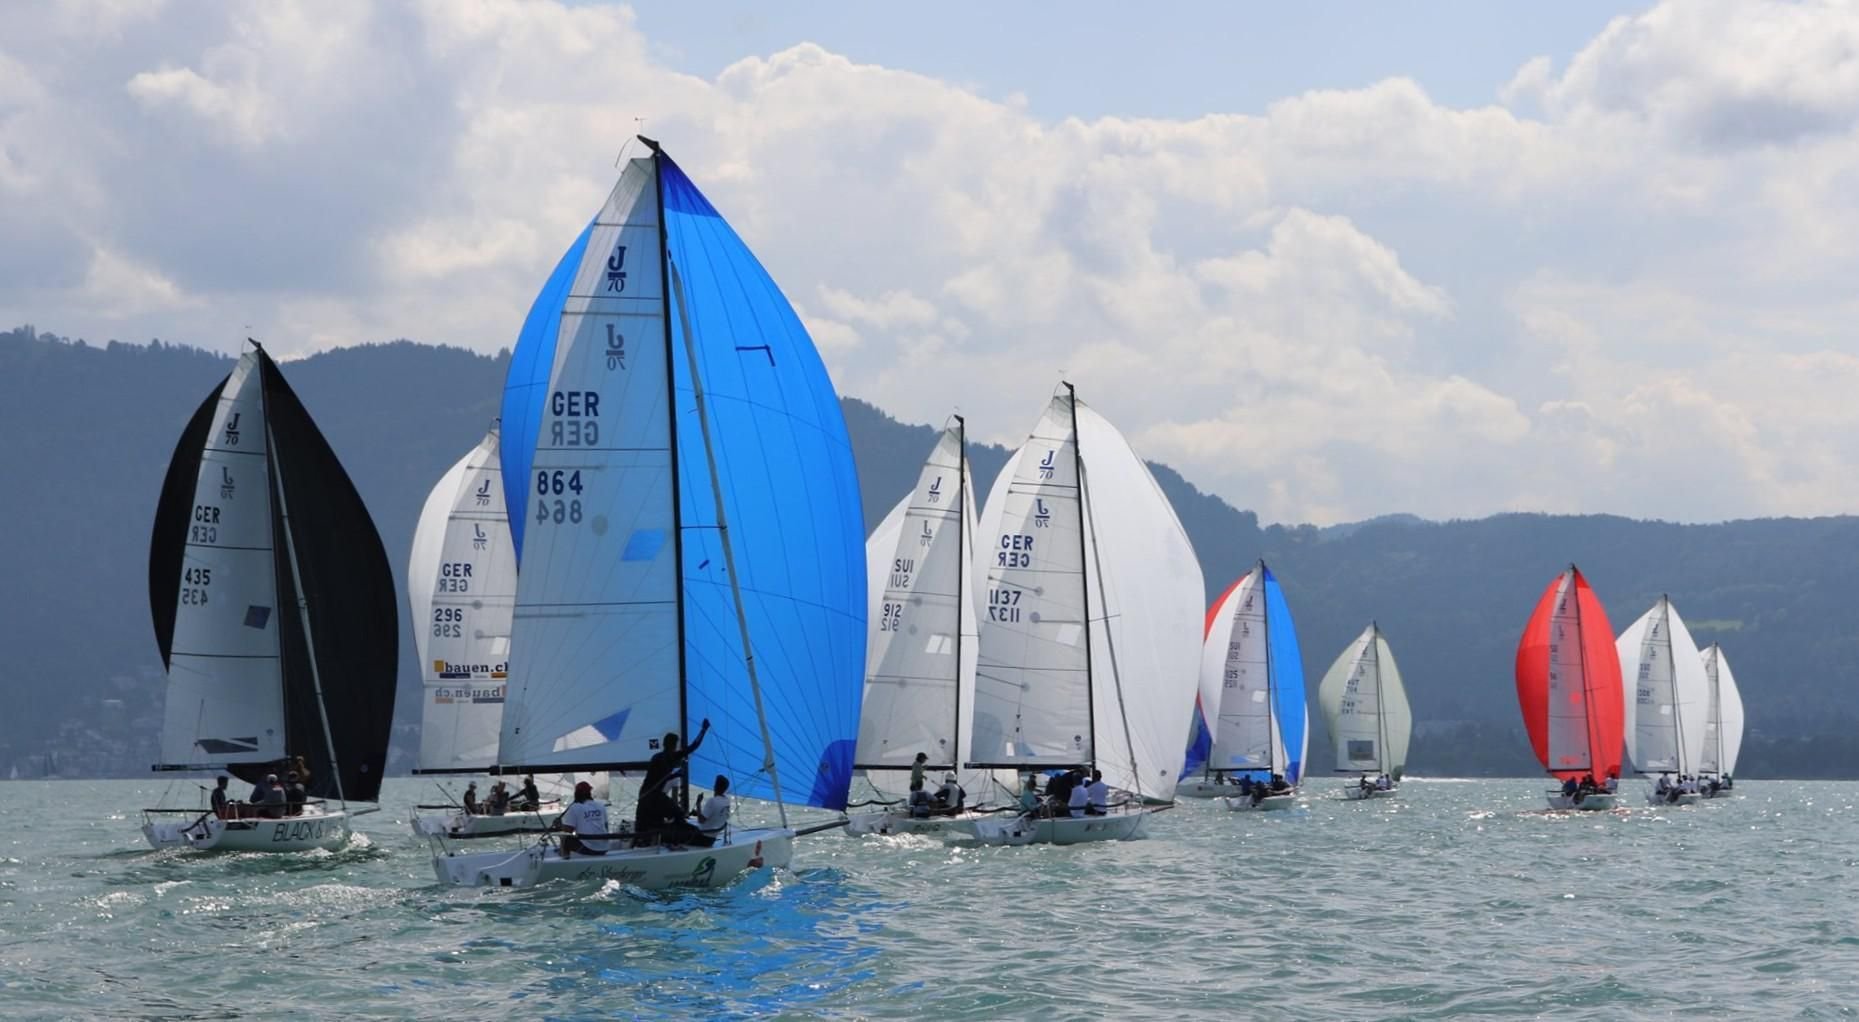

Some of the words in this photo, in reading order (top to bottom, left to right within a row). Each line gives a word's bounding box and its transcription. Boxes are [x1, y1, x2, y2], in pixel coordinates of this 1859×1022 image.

[608, 246, 626, 271] J
[607, 278, 625, 292] 70
[552, 391, 599, 417] GER
[537, 470, 583, 495] 864
[195, 505, 220, 524] GER
[1001, 534, 1033, 551] GER
[442, 563, 472, 577] GER
[895, 559, 914, 573] SUI
[185, 567, 211, 585] 435
[989, 589, 1022, 605] 1137
[434, 608, 462, 622] 296
[883, 604, 902, 618] 912
